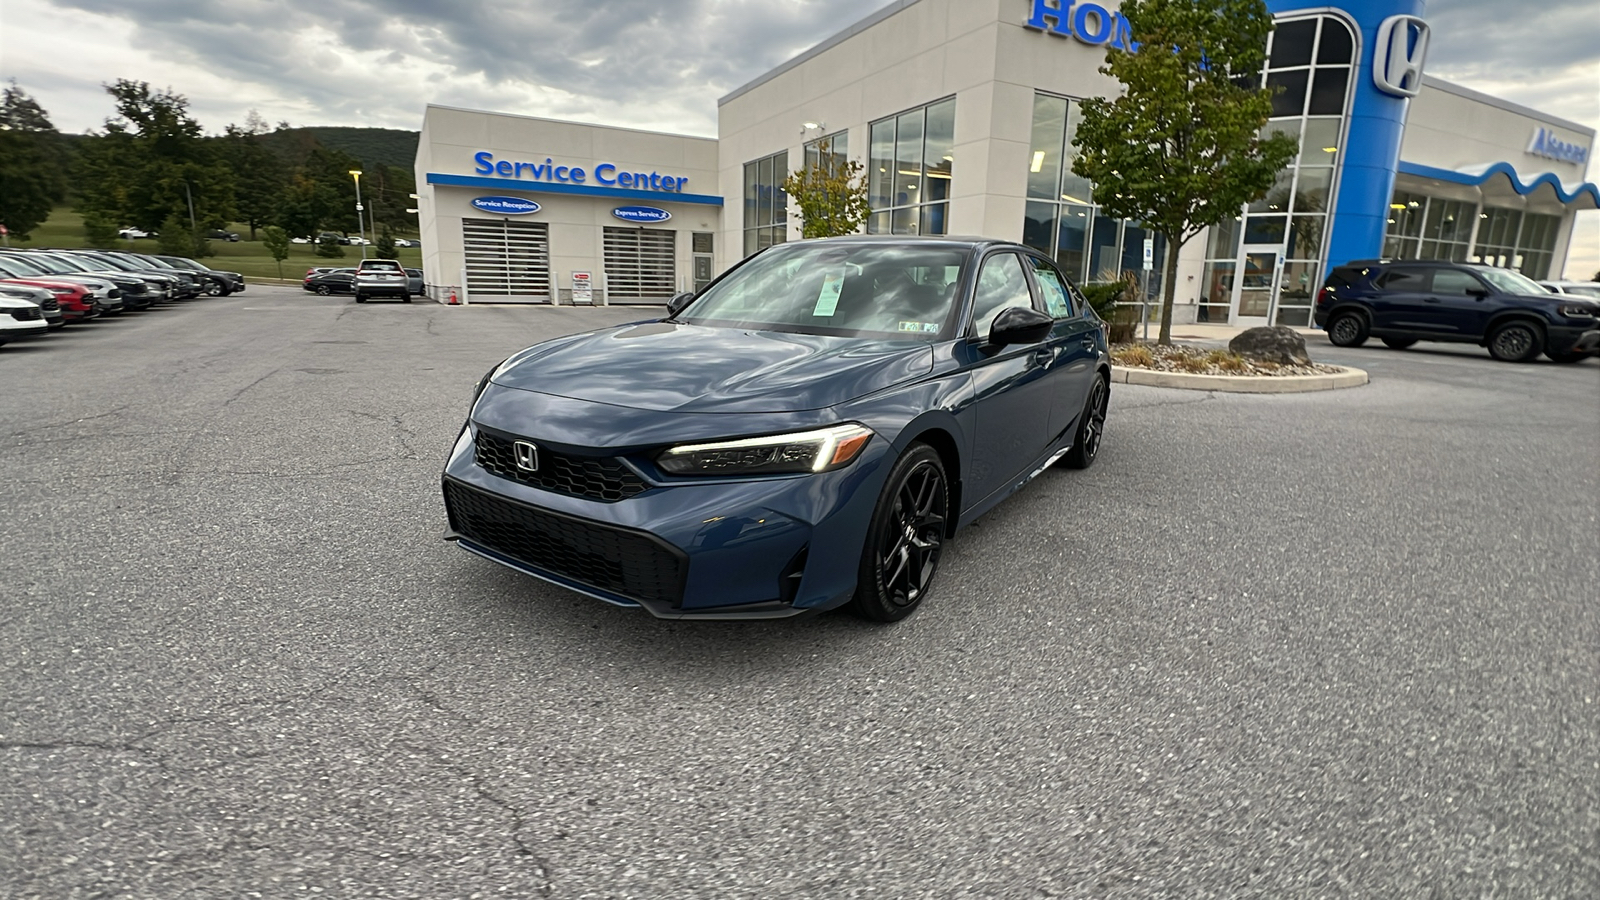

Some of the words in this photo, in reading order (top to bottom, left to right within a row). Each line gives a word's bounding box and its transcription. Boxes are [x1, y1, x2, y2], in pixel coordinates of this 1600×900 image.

[474, 151, 586, 183] Service
[594, 163, 689, 192] Center
[475, 199, 502, 208] Service
[502, 201, 537, 210] Reception
[615, 209, 638, 217] Express
[638, 210, 660, 218] Service
